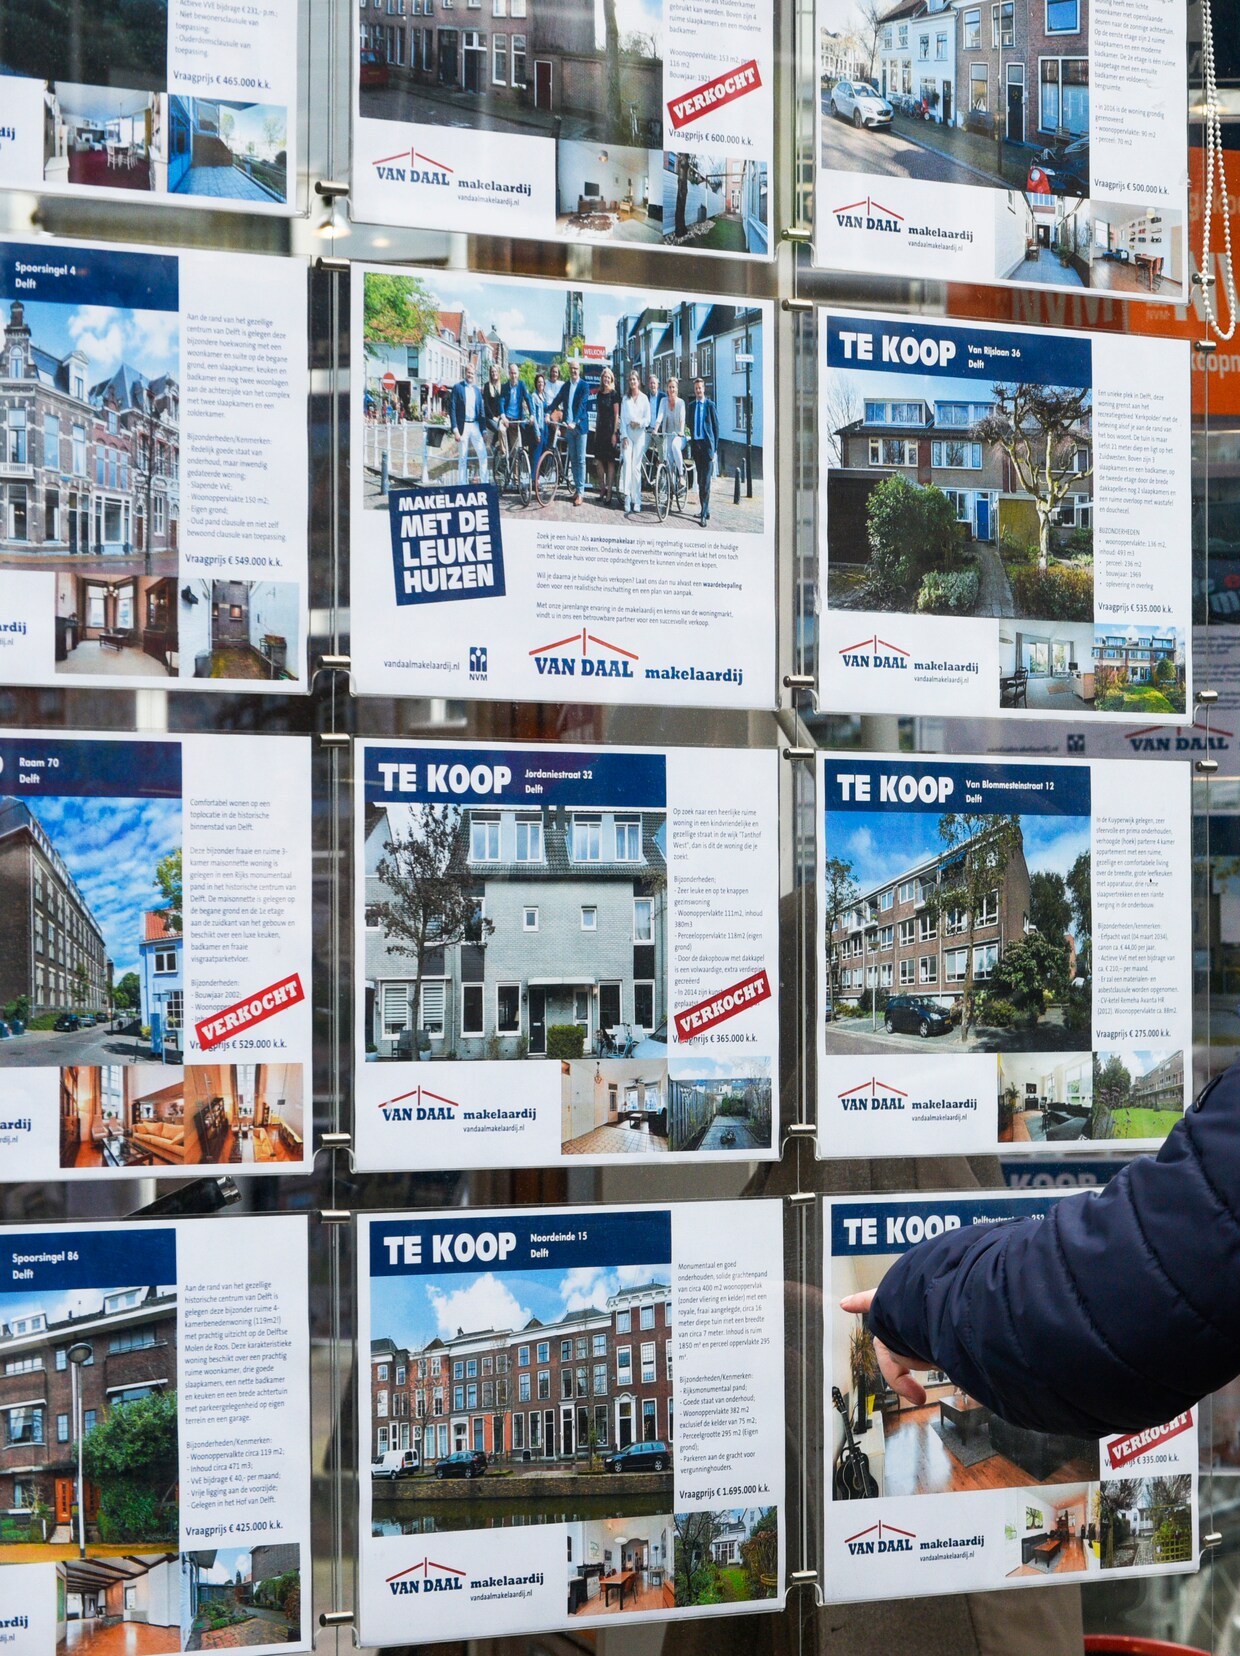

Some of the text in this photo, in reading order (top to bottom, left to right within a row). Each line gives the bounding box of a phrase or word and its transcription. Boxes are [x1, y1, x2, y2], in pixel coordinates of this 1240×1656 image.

[173, 70, 214, 85] Vraagprijs
[215, 75, 220, 84] €
[222, 75, 256, 88] 465.000
[673, 67, 755, 119] VERKOCHT
[668, 128, 704, 142] Vraagprijs
[705, 133, 710, 141] €
[711, 133, 740, 144] 600.000
[376, 166, 450, 186] VAN DAAL
[458, 179, 531, 197] makelaardij
[1094, 178, 1126, 192] Vraagprijs
[1126, 182, 1131, 191] €
[1132, 182, 1158, 194] 500.000
[836, 214, 901, 233] VAN DAAL
[908, 226, 973, 243] makelaardij
[15, 261, 76, 277] Spoorsingel 4
[15, 277, 36, 289] Delft
[838, 331, 956, 367] TE KOOP
[967, 344, 1021, 358] Van Rijslaan 36
[968, 359, 984, 369] Delft
[398, 491, 488, 511] MAKELAAR
[400, 508, 490, 538] MET DE
[590, 536, 635, 546] aankoopmakelaar
[402, 534, 492, 567] LEUKE
[185, 553, 226, 567] Vraagprijs
[228, 555, 233, 565] €
[234, 556, 266, 566] 549.000
[403, 563, 494, 594] HUIZEN
[703, 581, 742, 591] waardebepaling
[1098, 602, 1130, 613] Vraagprijs
[1130, 603, 1134, 612] €
[1135, 603, 1161, 613] 535.000
[383, 660, 460, 672] vandaalmakelaardij.nl
[534, 656, 634, 678] VAN DAAL
[842, 654, 907, 669] VAN DAAL
[914, 660, 978, 676] makelaardij
[469, 673, 487, 681] NVM
[644, 666, 742, 686] makelaardij
[913, 675, 969, 685] vandaalmakelaardij.nl
[19, 756, 59, 767] Raam 70
[18, 773, 40, 784] Delft
[378, 762, 512, 794] TE KOOP
[524, 768, 592, 779] Jordaniestraat 32
[524, 784, 543, 794] Delft
[836, 774, 954, 803] TE KOOP
[965, 779, 1054, 790] Van Blommesteinstraat 12
[965, 793, 982, 803] Delft
[201, 981, 297, 1040] VERKOCHT
[680, 978, 764, 1032] VERKOCHT
[710, 1034, 714, 1042] €
[716, 1034, 745, 1043] 365.000
[1096, 1029, 1128, 1040] Vraagprijs
[1128, 1029, 1133, 1038] €
[1134, 1029, 1160, 1038] 275.000
[228, 1039, 237, 1049] €
[239, 1039, 271, 1049] 529.000
[840, 1098, 905, 1111] VAN DAAL
[911, 1098, 977, 1113] makelaardij
[382, 1107, 455, 1121] VAN DAAL
[463, 1108, 536, 1121] makelaardij
[911, 1113, 967, 1122] vandaalmakelaardij.nl
[462, 1123, 524, 1133] vandaalmakelaardij.nl
[530, 1231, 588, 1242] Noordeinde 15
[843, 1217, 877, 1245] TE
[383, 1231, 516, 1265] TE KOOP
[530, 1247, 549, 1258] Delft
[12, 1250, 79, 1265] Spoorsingel 86
[12, 1268, 34, 1279] Delft
[679, 1487, 715, 1501] Vraagprijs
[716, 1487, 721, 1496] €
[722, 1484, 757, 1496] 1.695.000
[185, 1524, 227, 1538] Vraagprijs
[228, 1523, 234, 1533] €
[235, 1521, 268, 1532] 425.000
[848, 1538, 913, 1555] VAN DAAL
[919, 1535, 984, 1550] makelaardij
[919, 1550, 974, 1562] vandaalmakelaardij.nl
[389, 1575, 462, 1595] VAN DAAL
[470, 1572, 544, 1589] makelaardij
[470, 1589, 532, 1601] vandaalmakelaardij.nl
